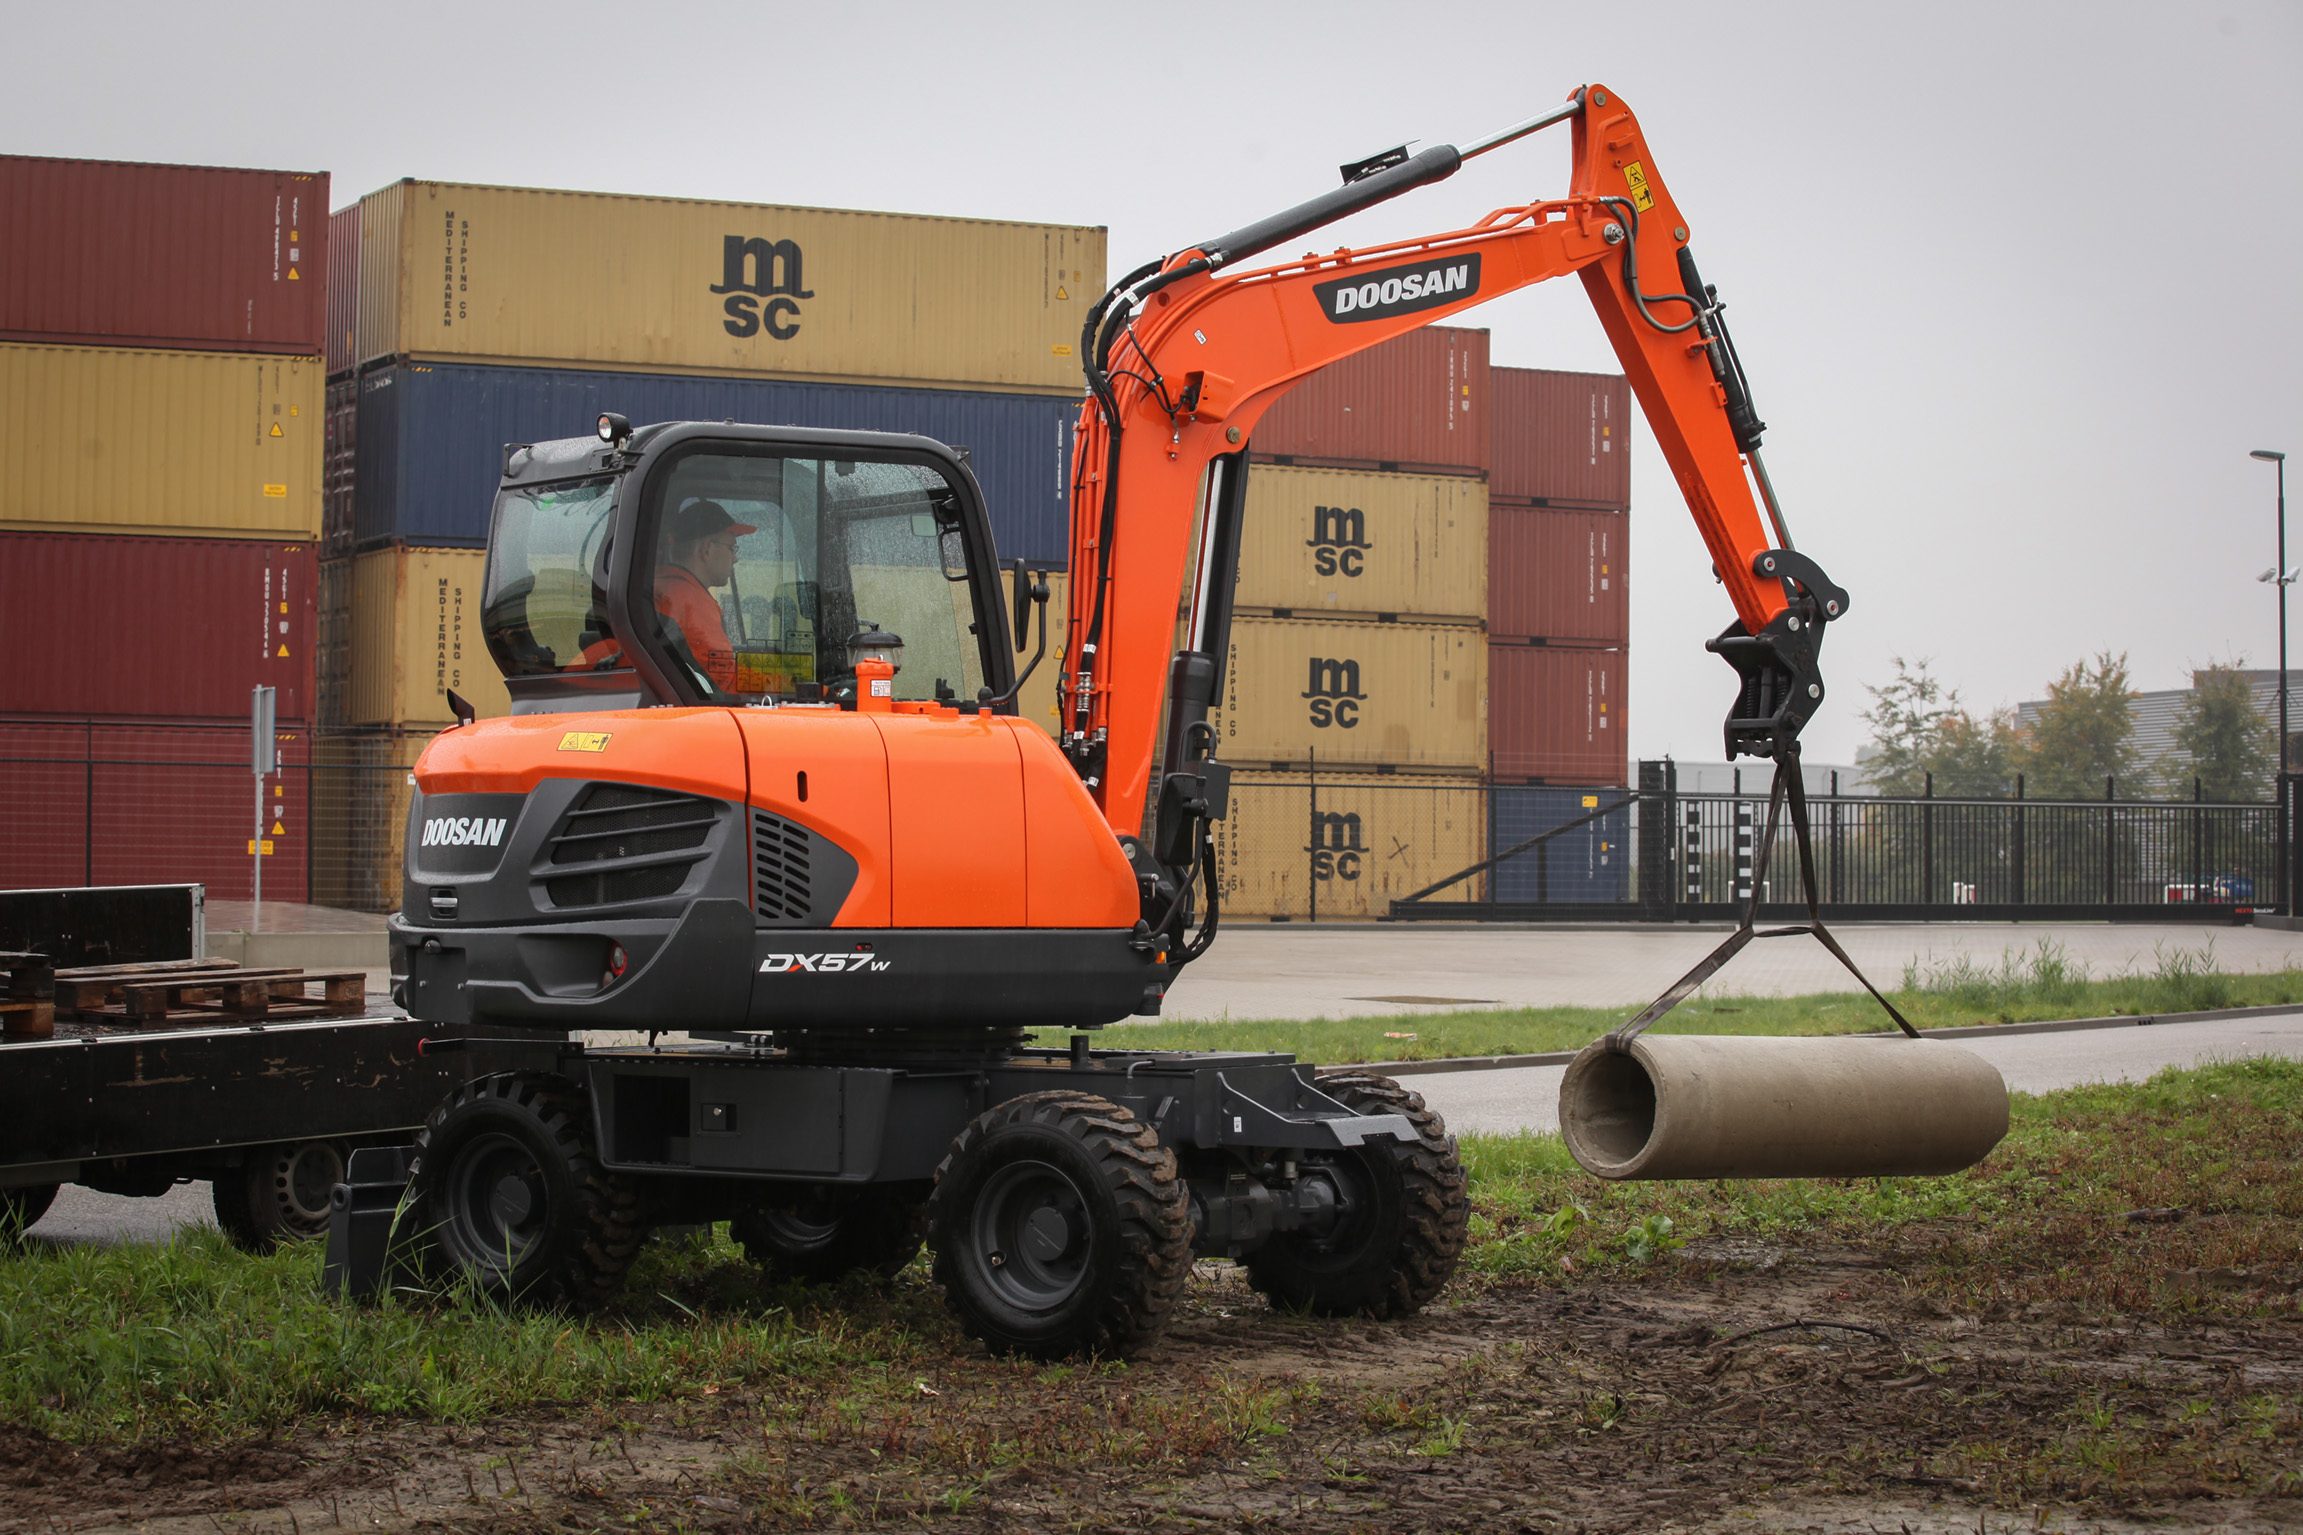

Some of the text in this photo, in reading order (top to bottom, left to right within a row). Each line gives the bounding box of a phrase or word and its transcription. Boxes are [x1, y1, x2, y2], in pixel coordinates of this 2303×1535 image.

[444, 211, 455, 327] MEDITERRANEAN
[459, 221, 469, 319] SHIPPING CO
[1335, 264, 1468, 315] DOOSAN
[437, 578, 448, 695] MEDITERRANEAN
[452, 588, 462, 687] SHIPPING CO
[1229, 644, 1237, 737] SHIPPING CO
[421, 817, 508, 847] DOOSAN
